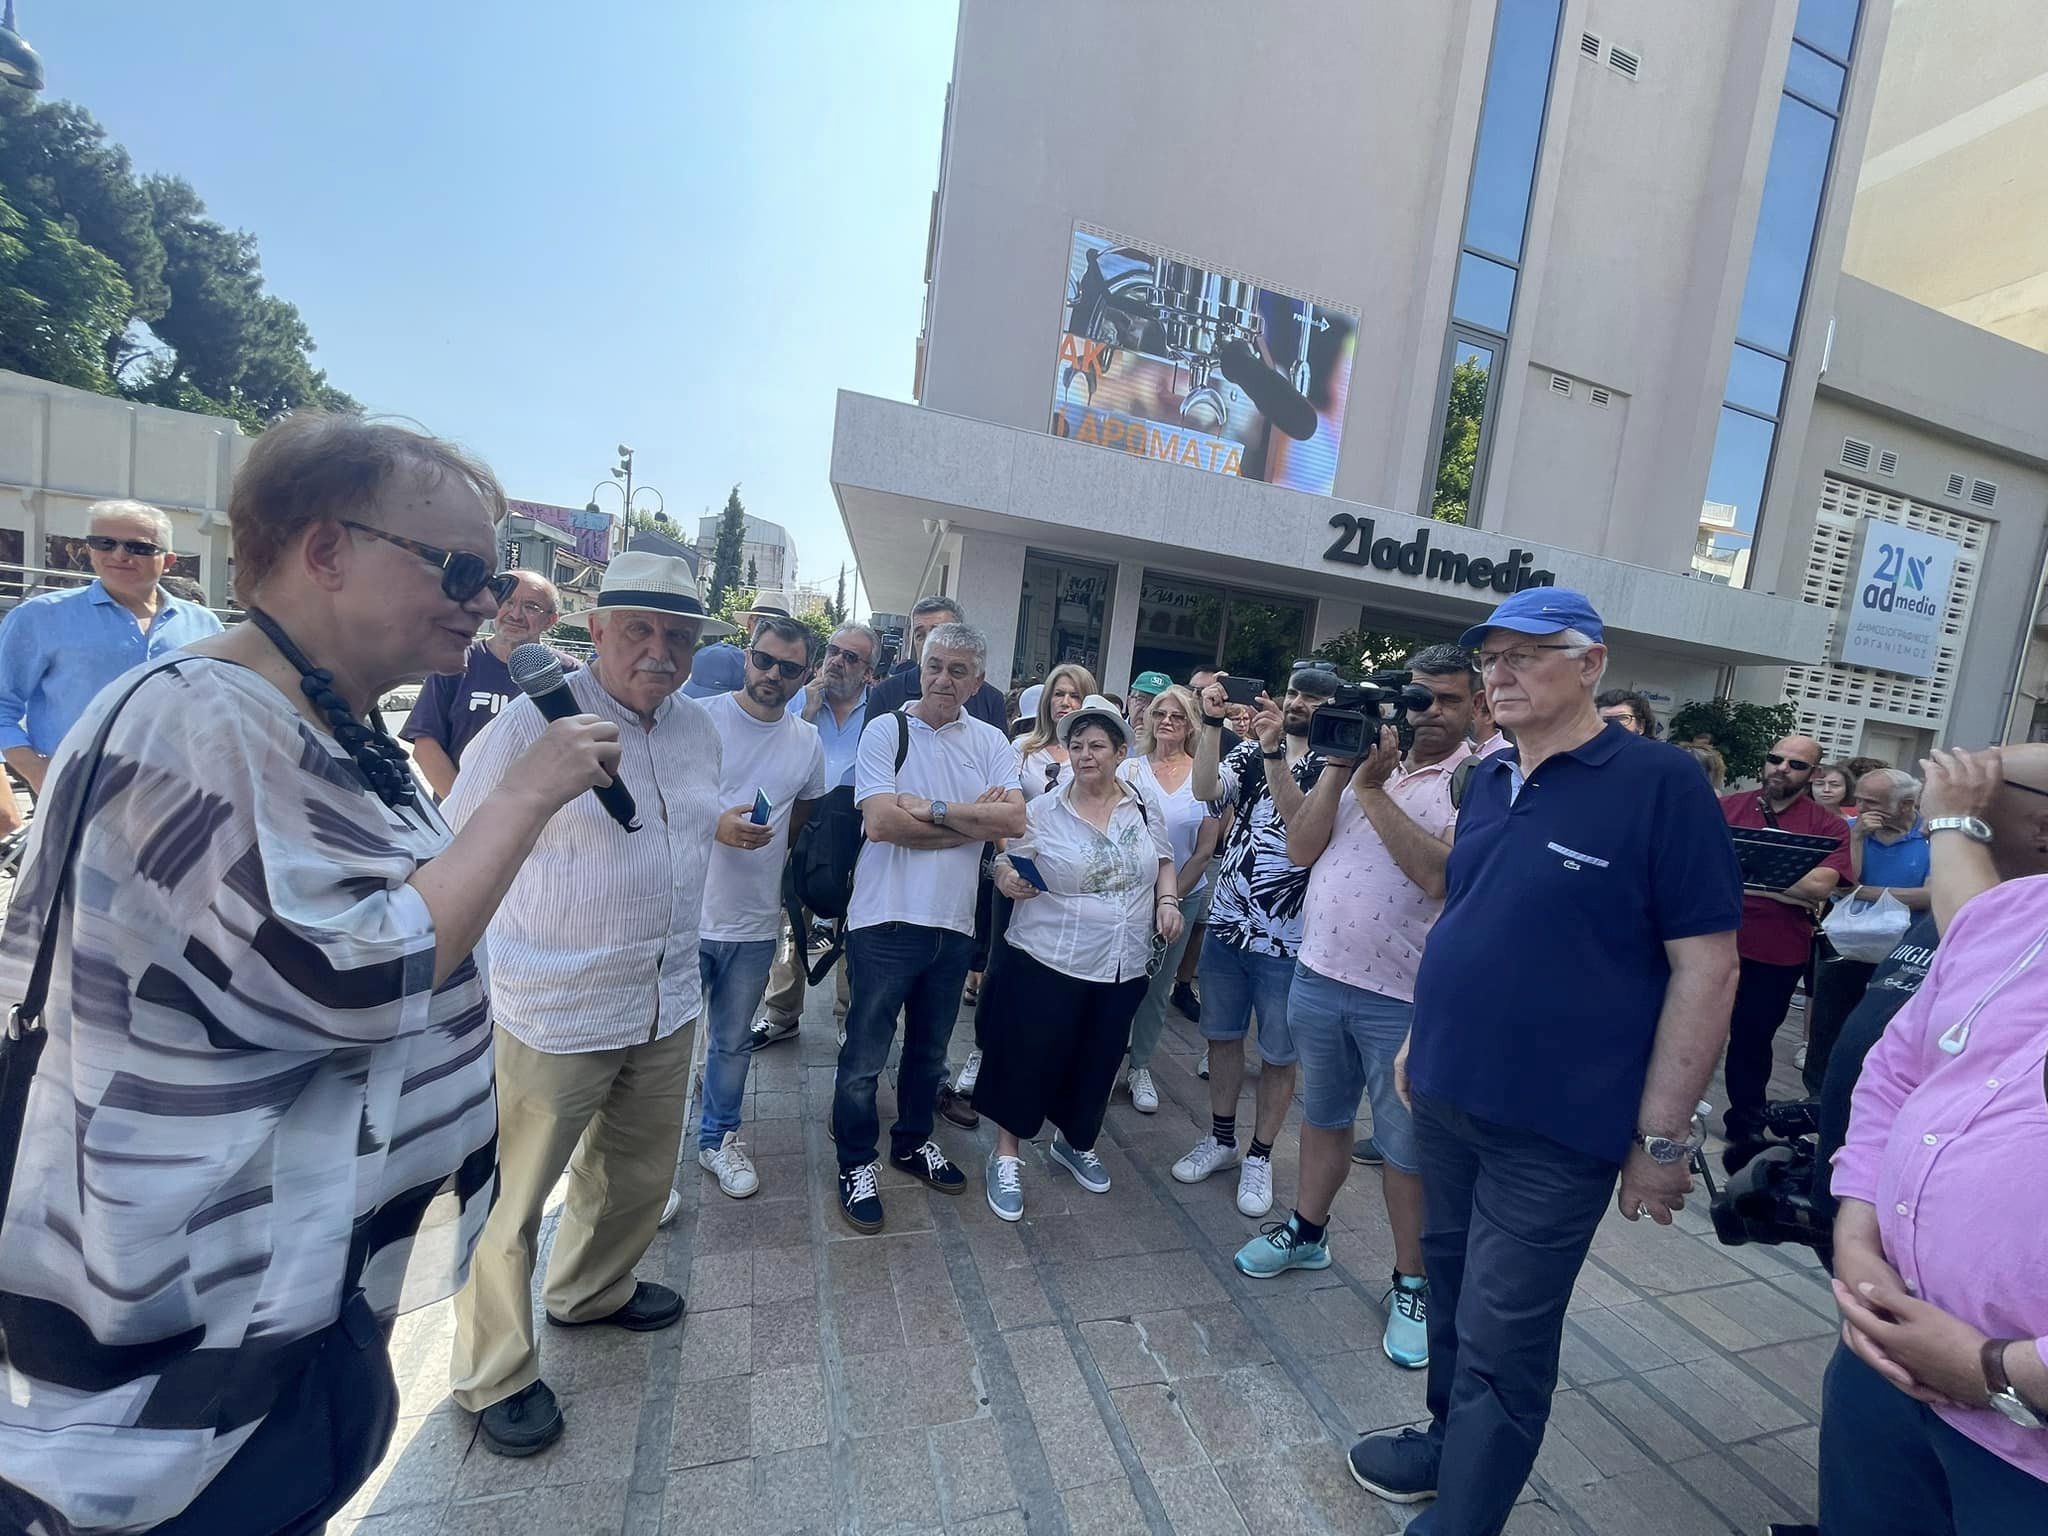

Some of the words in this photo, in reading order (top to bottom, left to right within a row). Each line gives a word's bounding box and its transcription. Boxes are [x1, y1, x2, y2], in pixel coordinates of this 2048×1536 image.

[1873, 543, 1905, 582] 21
[1863, 582, 1897, 612] ad
[1895, 596, 1936, 617] media
